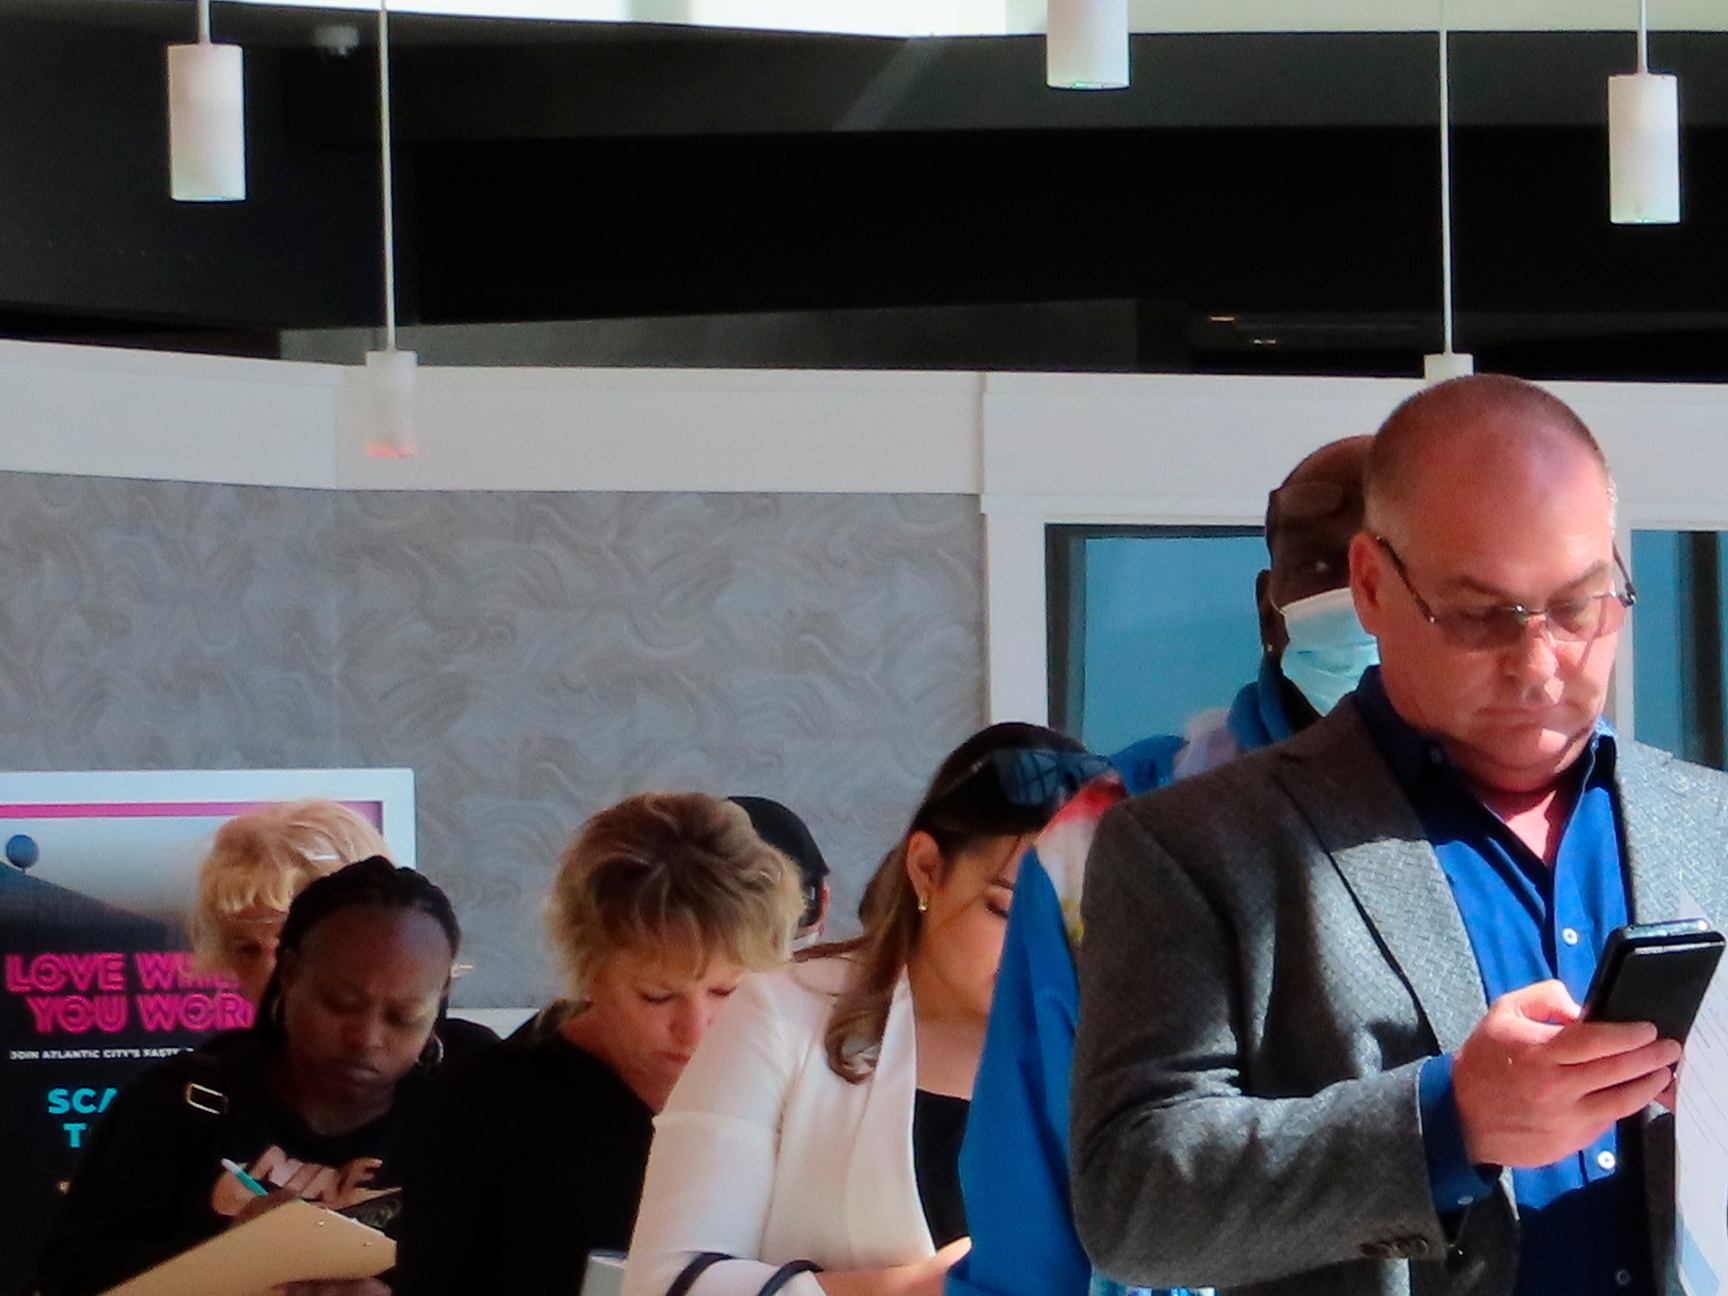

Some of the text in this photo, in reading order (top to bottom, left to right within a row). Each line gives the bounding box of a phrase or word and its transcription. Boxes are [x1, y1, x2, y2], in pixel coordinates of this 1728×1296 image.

[6, 953, 127, 992] LOVE
[26, 993, 256, 1033] YOU WOR
[9, 1050, 40, 1060] JOIN
[41, 1050, 100, 1059] ATLANTIC
